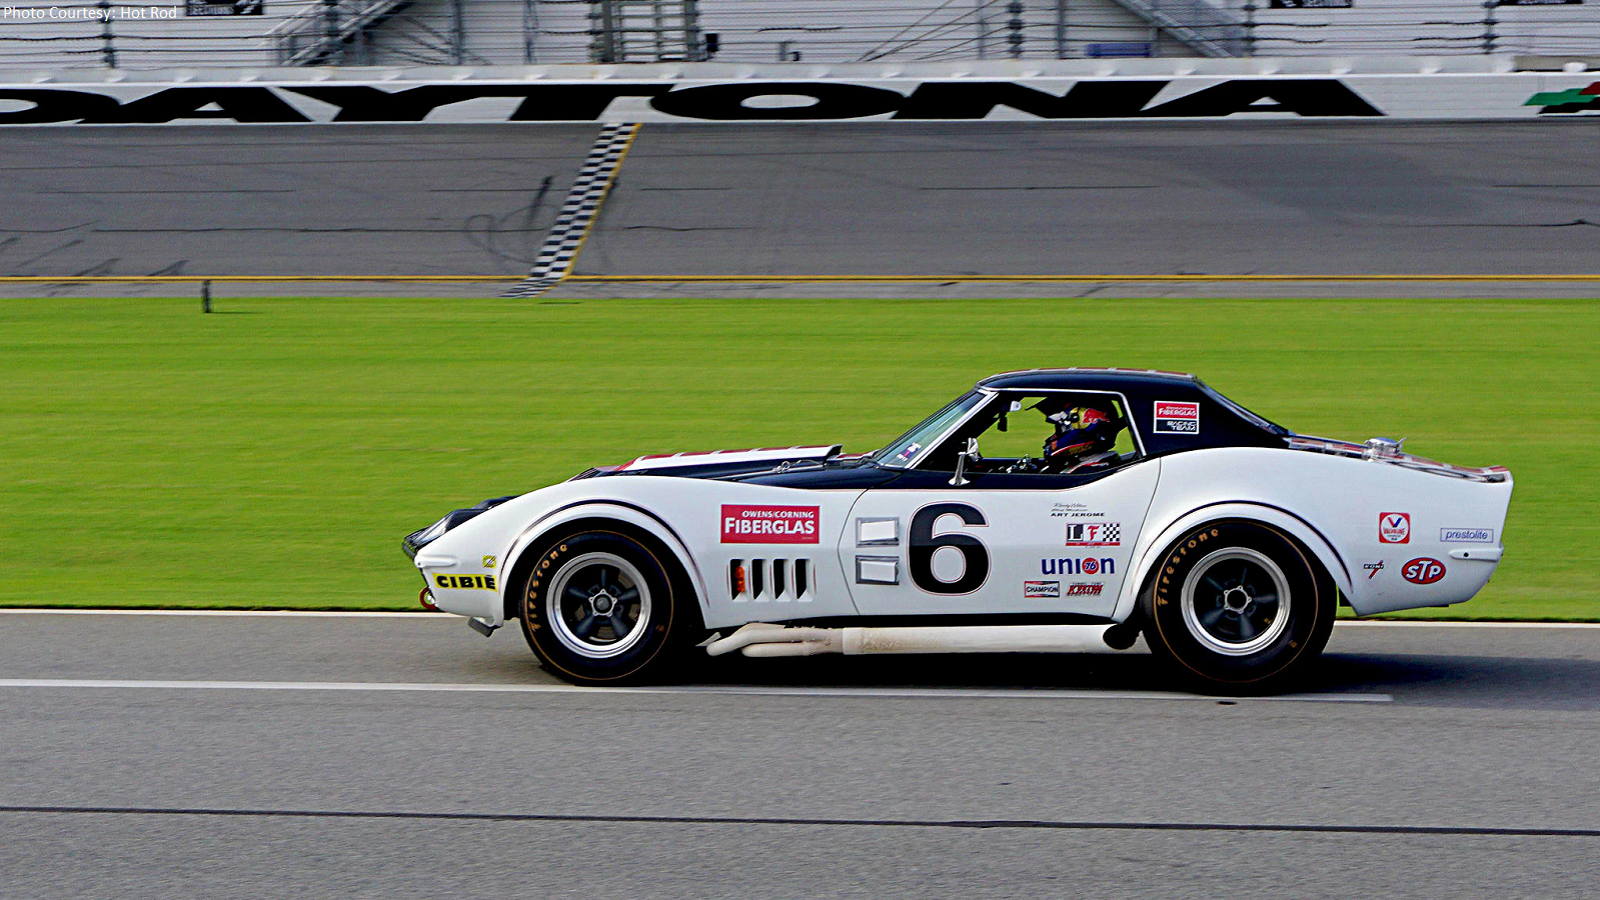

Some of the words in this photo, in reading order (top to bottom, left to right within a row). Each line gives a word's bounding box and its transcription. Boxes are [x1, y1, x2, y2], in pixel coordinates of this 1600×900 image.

[724, 517, 815, 534] FIBERGLAS
[1445, 530, 1489, 541] prestolite
[909, 502, 990, 595] 6
[1084, 561, 1097, 571] 76
[1405, 560, 1442, 581] STP
